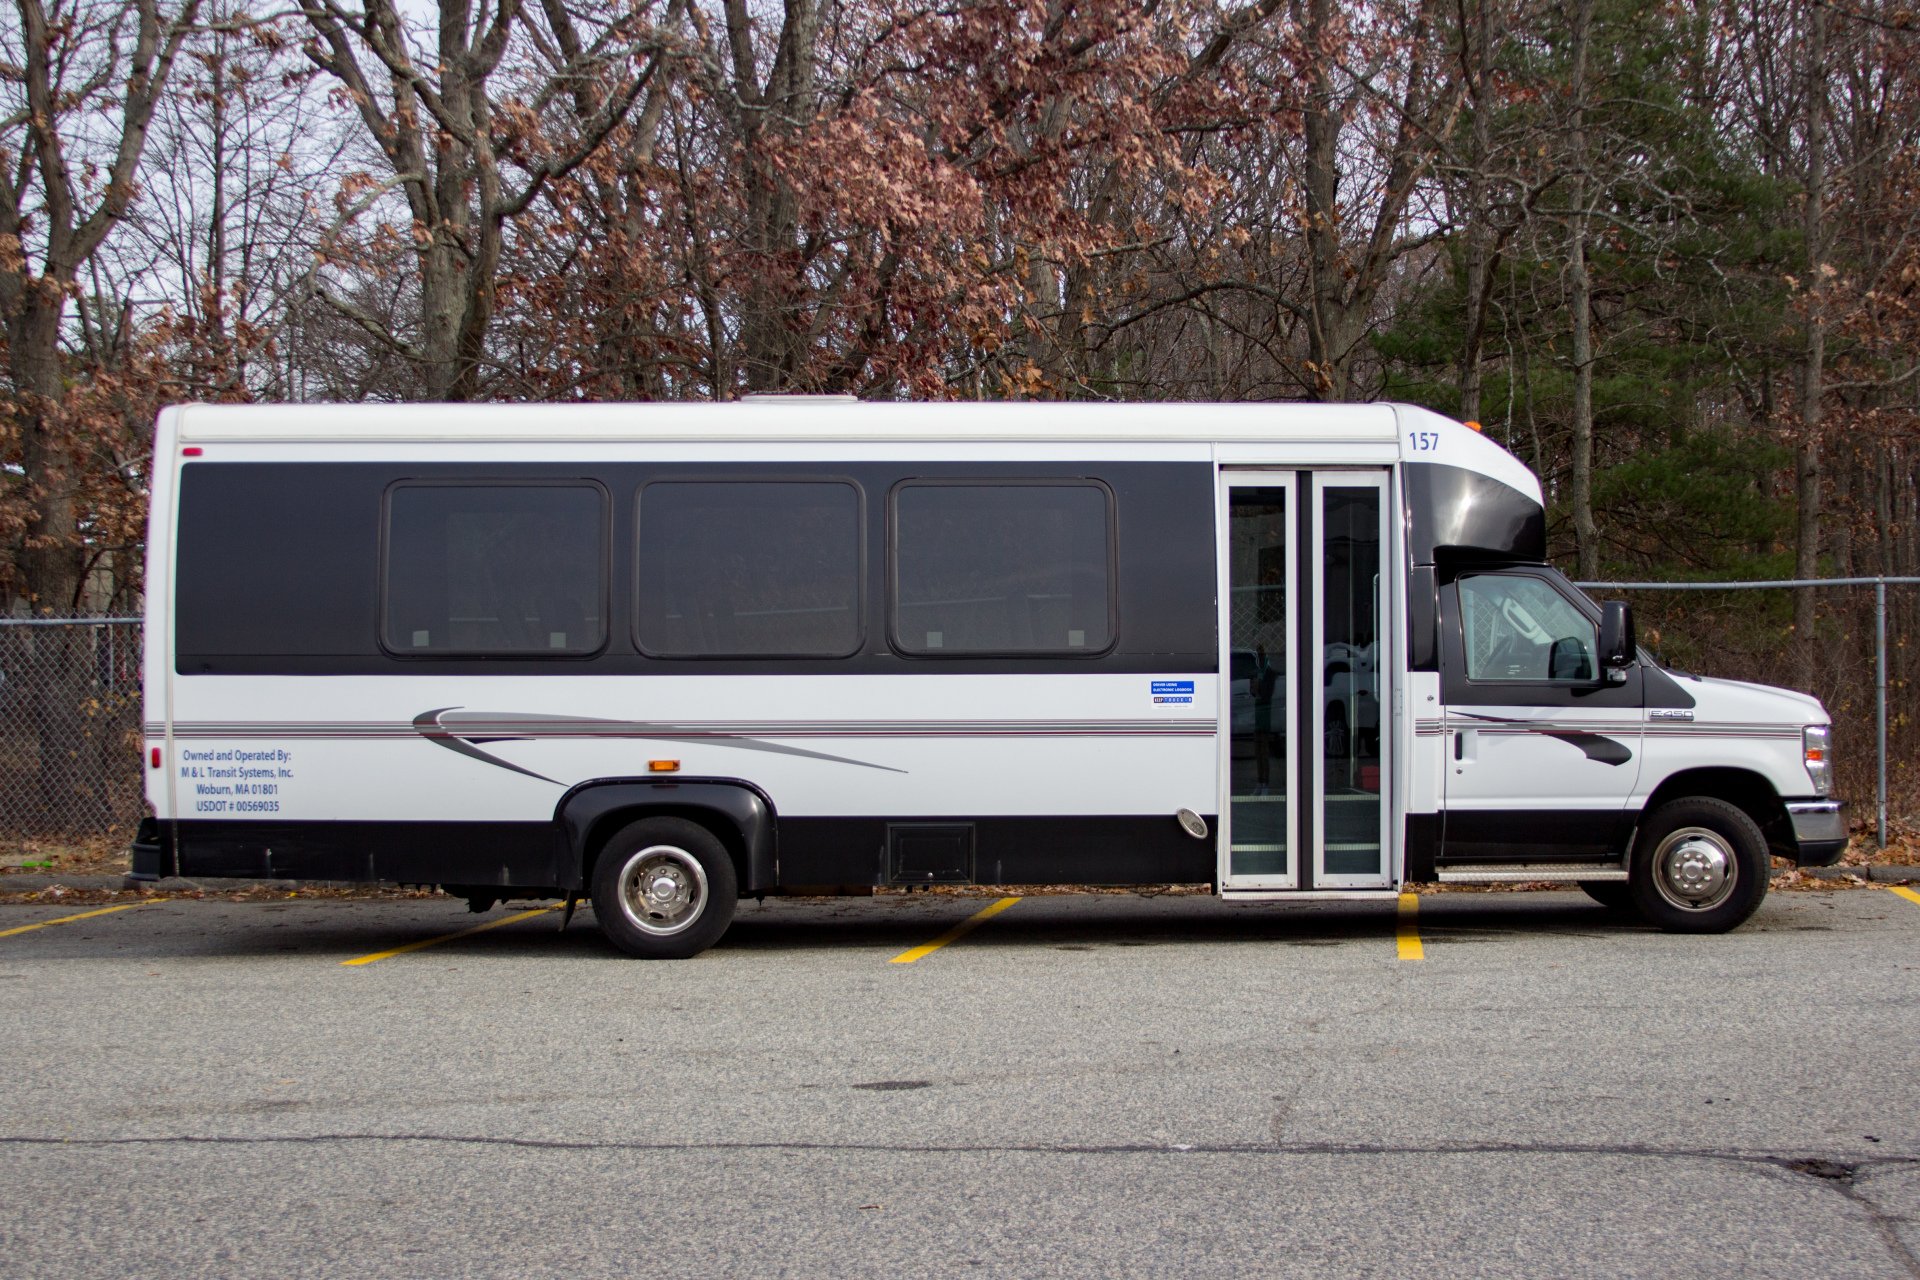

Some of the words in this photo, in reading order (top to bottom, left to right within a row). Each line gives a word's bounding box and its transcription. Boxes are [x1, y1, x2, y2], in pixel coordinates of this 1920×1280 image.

[1409, 432, 1439, 451] 157
[183, 749, 214, 761] Owned
[216, 749, 233, 761] and
[234, 749, 276, 763] Operated
[277, 749, 292, 764] By:
[181, 767, 190, 778] M
[191, 767, 199, 778] &
[200, 767, 205, 778] L
[207, 767, 237, 778] Transit
[239, 767, 277, 780] Systems,
[278, 767, 294, 778] Inc.
[196, 784, 234, 796] Woburn,
[235, 784, 250, 795] MA
[251, 784, 278, 795] 01801
[196, 800, 227, 812] USDOT
[229, 801, 235, 811] #
[236, 800, 280, 812] 00569035
